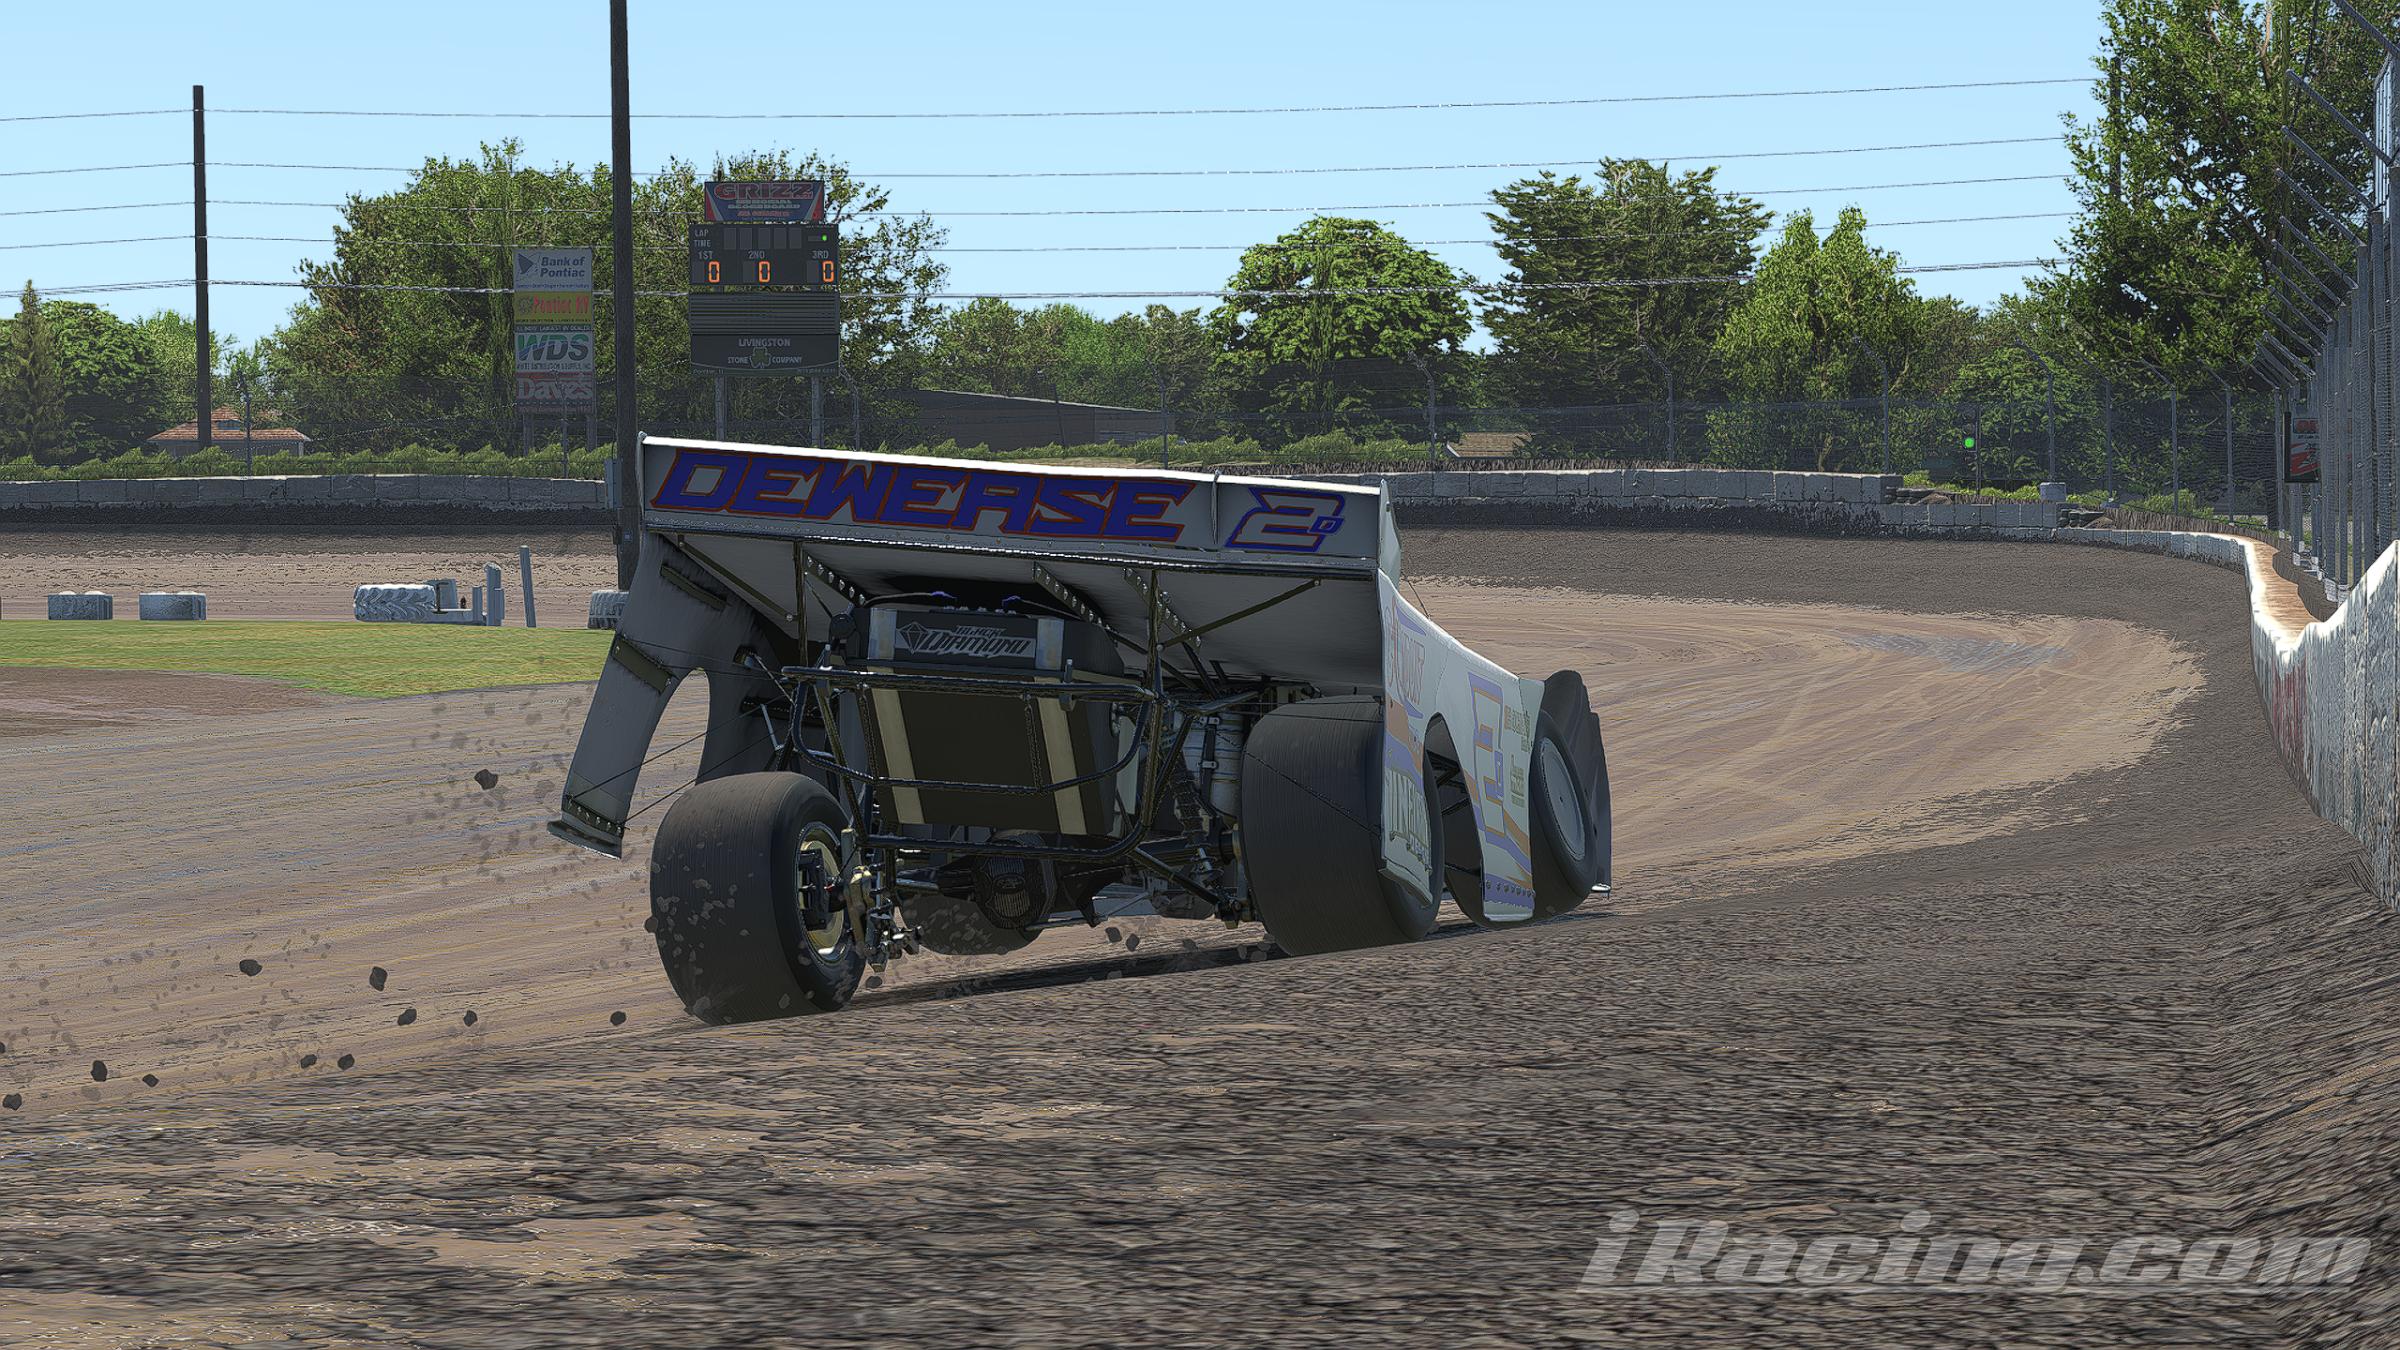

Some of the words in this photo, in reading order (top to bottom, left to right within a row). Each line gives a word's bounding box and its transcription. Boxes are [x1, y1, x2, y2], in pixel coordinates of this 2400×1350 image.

[694, 229, 709, 237] LAP
[694, 240, 711, 248] TIME
[698, 251, 713, 259] 1ST
[748, 251, 765, 259] 2ND
[812, 251, 829, 259] 3RD
[541, 256, 570, 267] Bank
[572, 256, 586, 267] of
[540, 268, 586, 278] Pontiac
[708, 260, 720, 283] 0
[758, 260, 771, 283] 0
[822, 260, 835, 283] 0
[518, 334, 589, 361] WDS
[738, 338, 792, 347] LIVINGSTON
[727, 356, 749, 364] STONE
[771, 356, 802, 364] COMPANY
[650, 449, 1196, 543] DEWEASE
[927, 631, 1032, 657] DIAMOND
